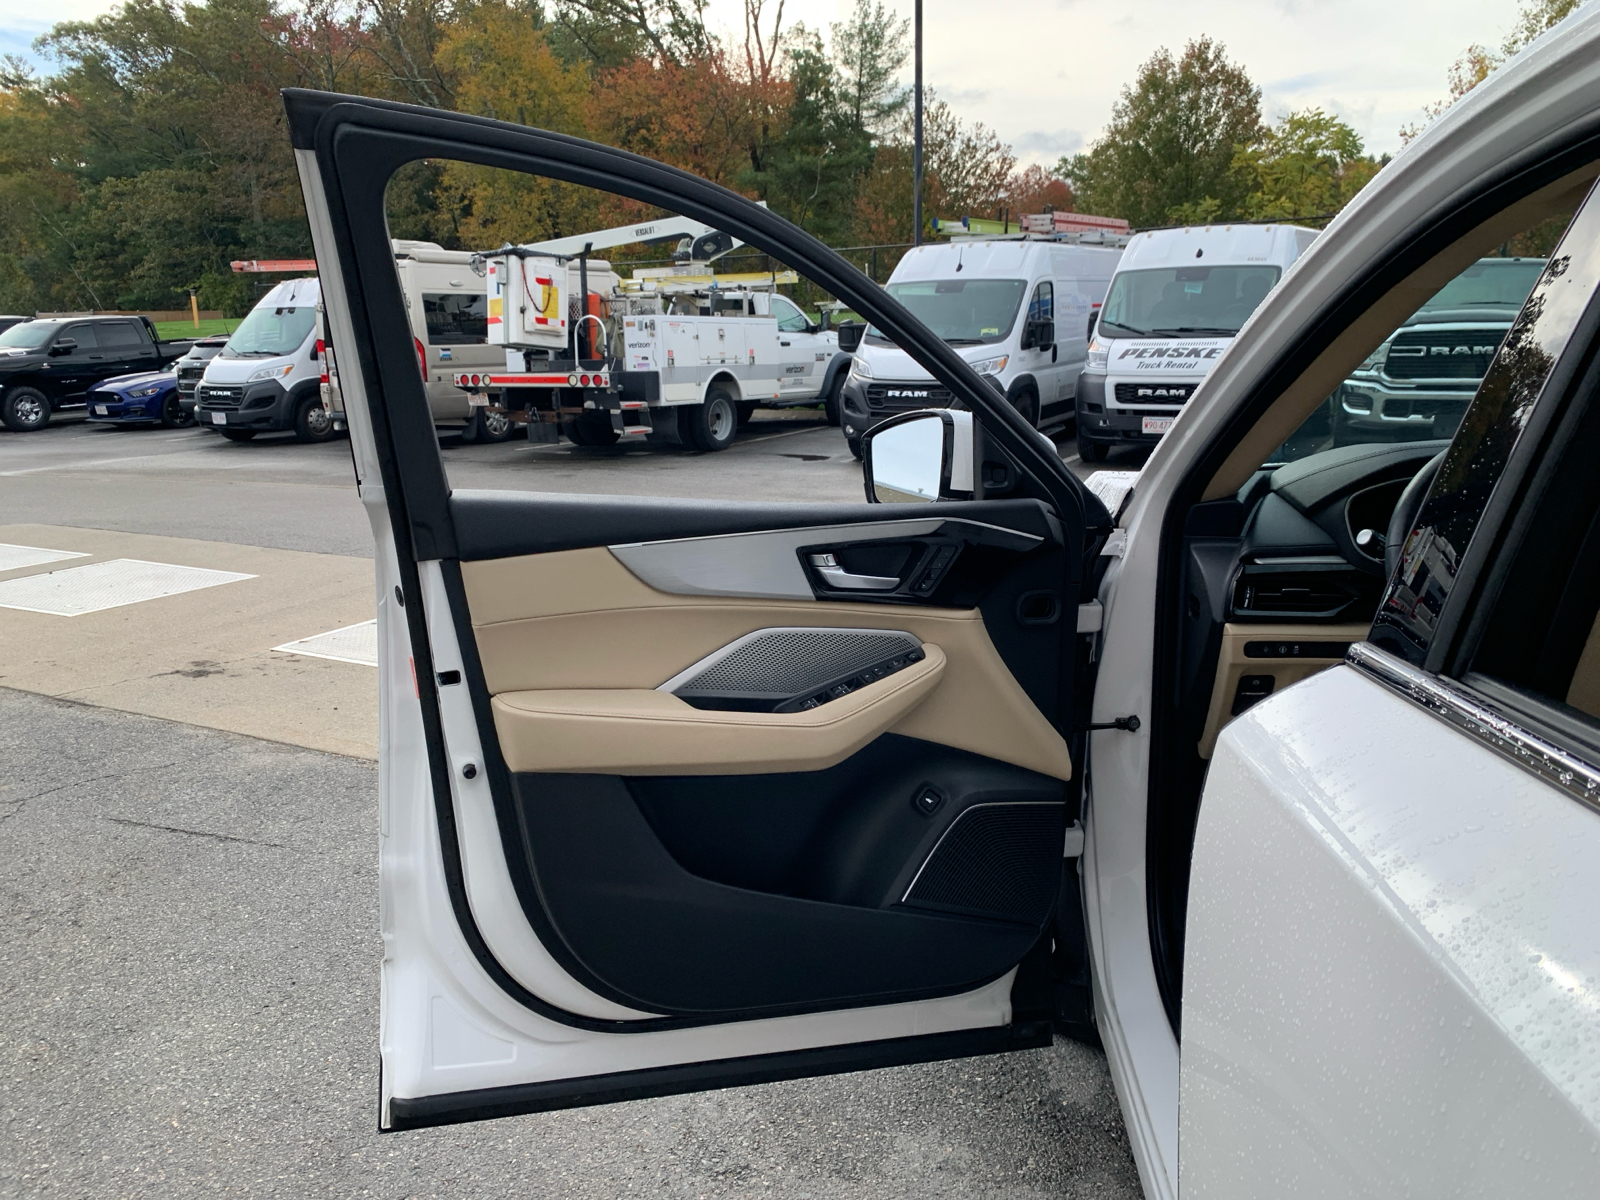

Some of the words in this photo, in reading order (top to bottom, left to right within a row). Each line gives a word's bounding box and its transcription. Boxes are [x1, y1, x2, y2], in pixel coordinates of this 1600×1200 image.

[628, 341, 651, 349] verizon
[1117, 347, 1225, 360] PENSKE
[1430, 345, 1495, 356] RAM
[785, 364, 806, 374] verizon
[1136, 361, 1163, 370] Truck
[1163, 361, 1199, 370] Rental
[887, 390, 929, 398] RAM
